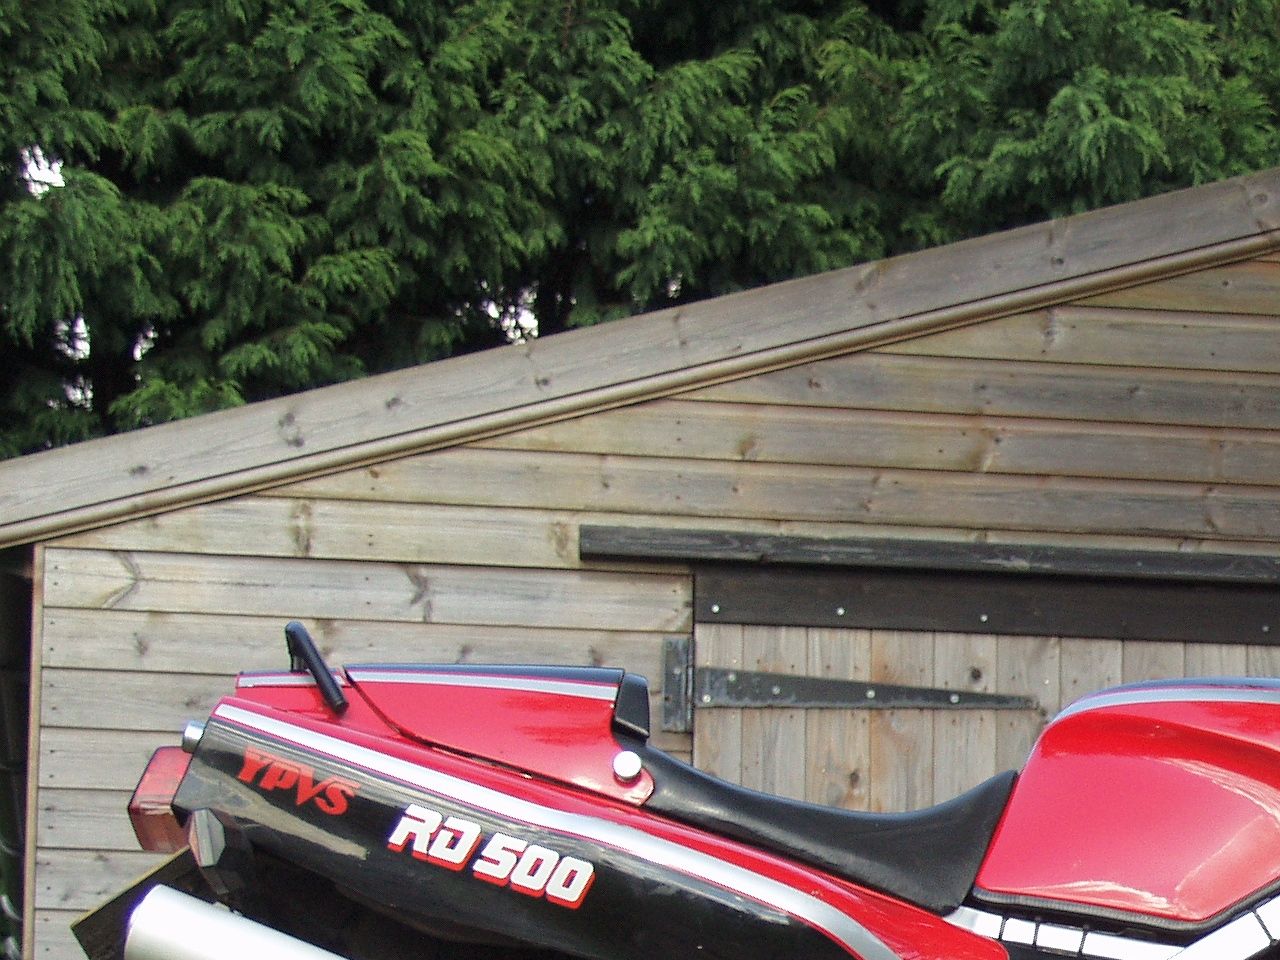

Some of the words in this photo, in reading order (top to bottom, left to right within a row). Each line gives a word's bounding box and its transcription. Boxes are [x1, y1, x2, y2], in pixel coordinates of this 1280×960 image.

[236, 746, 361, 816] YPVS
[387, 803, 482, 871] RD
[472, 831, 596, 910] 500
